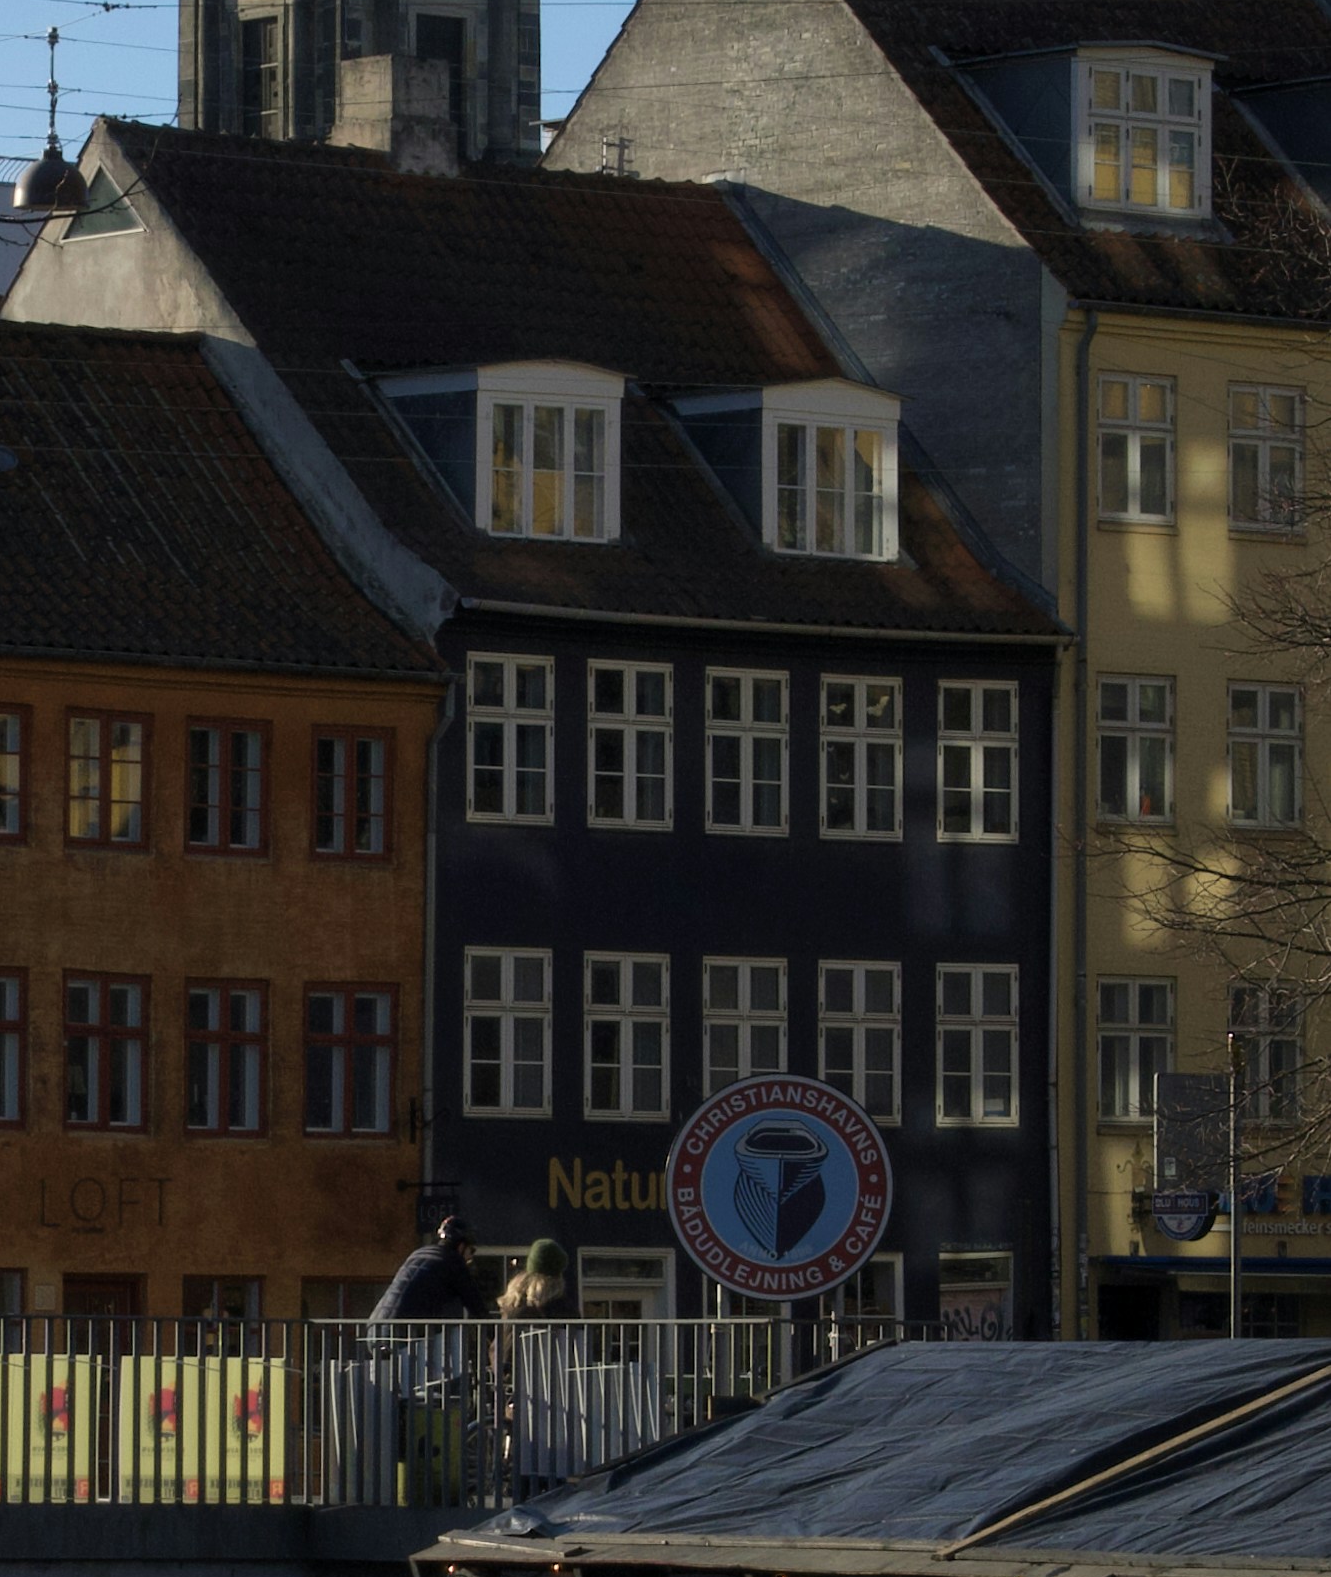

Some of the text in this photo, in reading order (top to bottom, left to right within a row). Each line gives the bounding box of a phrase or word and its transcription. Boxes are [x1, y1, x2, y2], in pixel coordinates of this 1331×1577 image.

[687, 1085, 878, 1165] CHRISTIANSHAVNS
[40, 1177, 172, 1227] LOFT
[677, 1186, 882, 1290] BÅDUDLEJNING & CAFÉ
